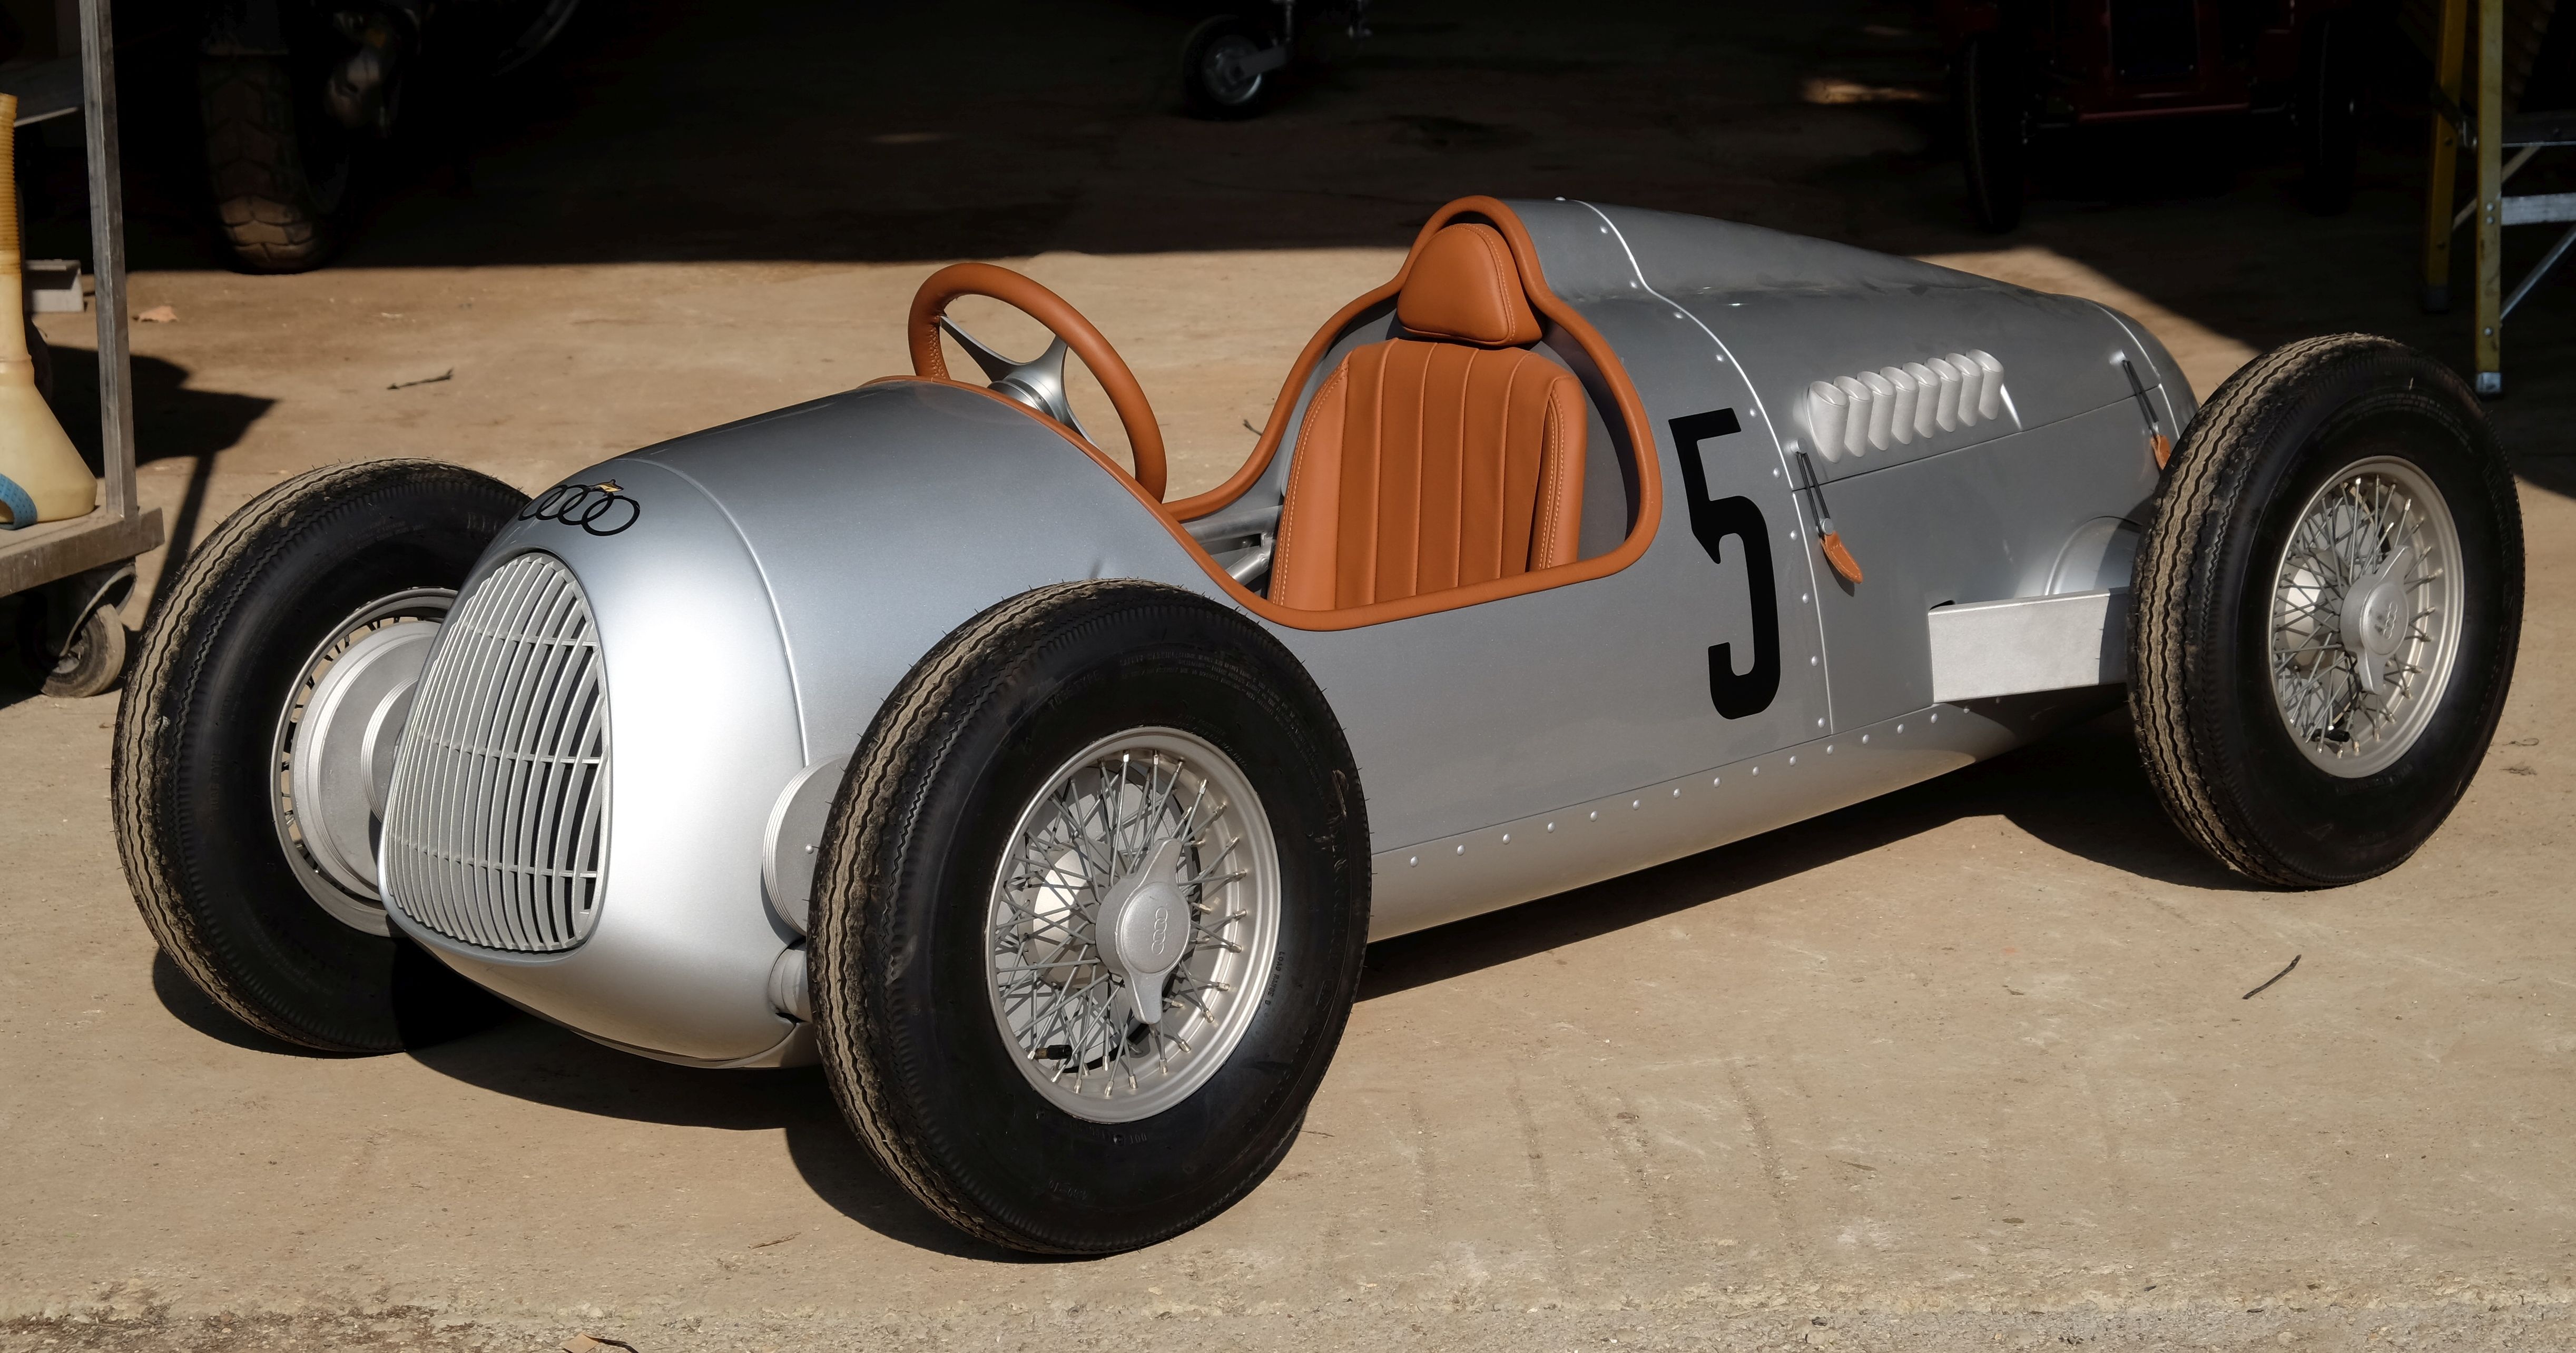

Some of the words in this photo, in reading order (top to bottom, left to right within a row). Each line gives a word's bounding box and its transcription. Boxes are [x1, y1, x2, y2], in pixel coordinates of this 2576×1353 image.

[1668, 408, 1781, 719] 5
[1275, 951, 1285, 972] LOAD
[1267, 974, 1280, 997] RANGE
